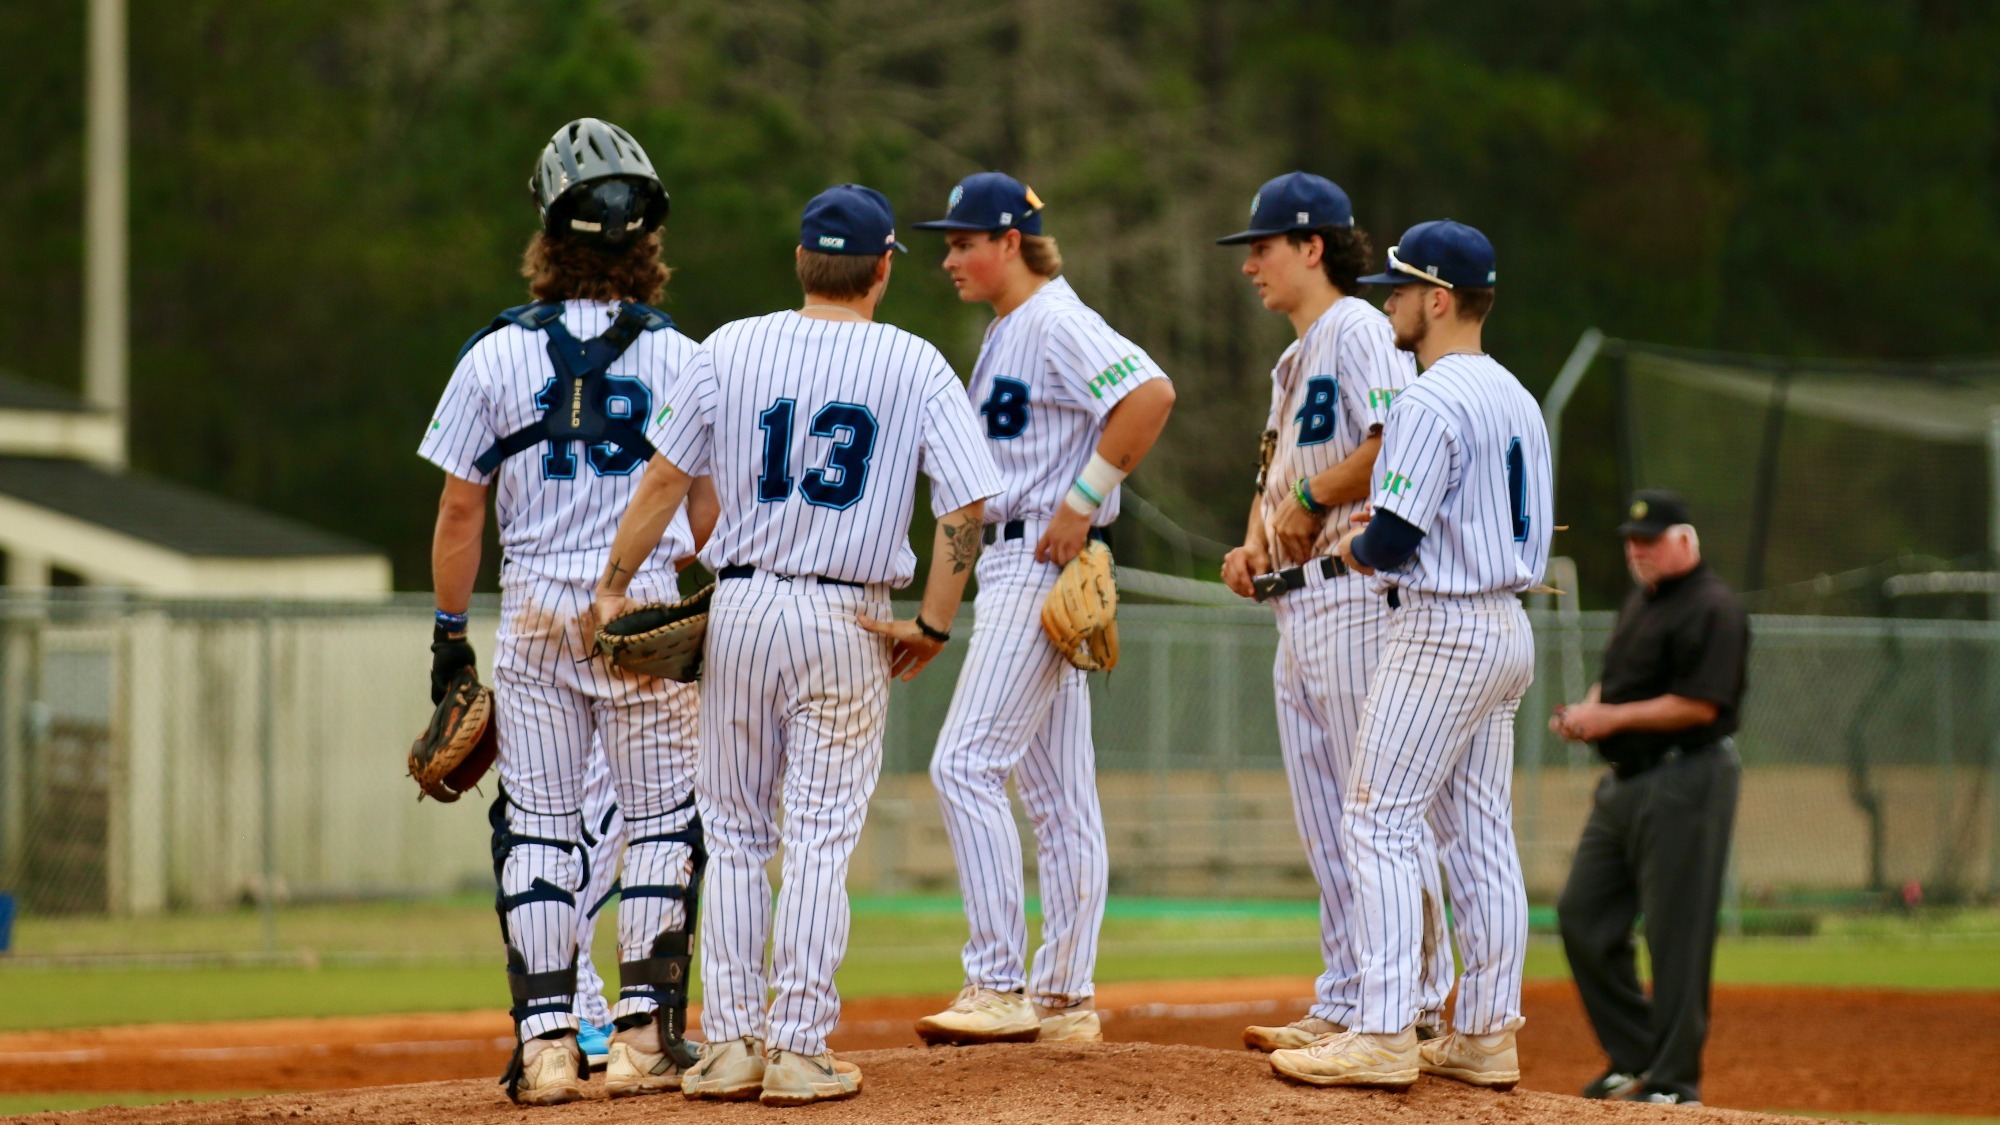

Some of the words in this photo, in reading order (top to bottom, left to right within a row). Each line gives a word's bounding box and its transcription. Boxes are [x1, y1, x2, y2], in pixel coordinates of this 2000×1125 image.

[570, 377, 583, 429] SHIELD
[980, 374, 1031, 439] B
[1087, 353, 1146, 400] PBC
[1293, 374, 1339, 447] B
[757, 397, 880, 512] 13
[1506, 436, 1530, 542] 1
